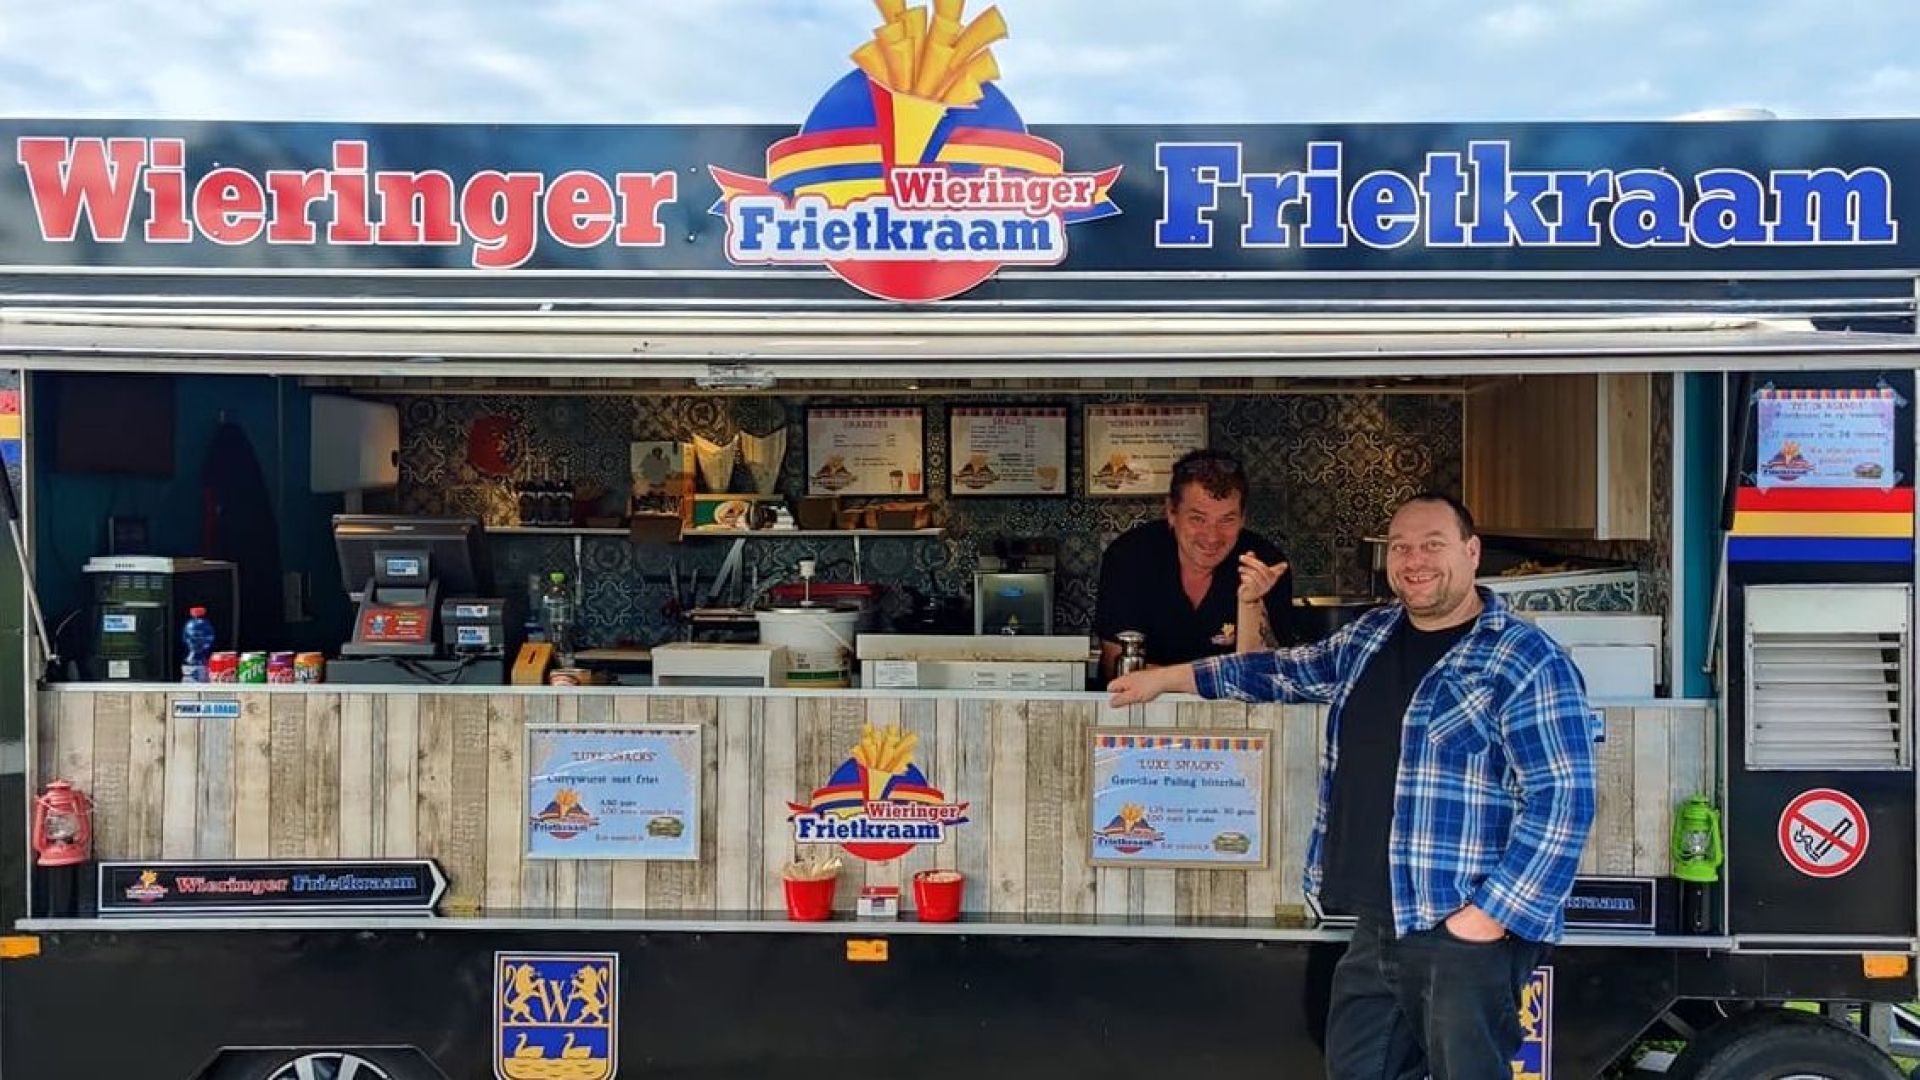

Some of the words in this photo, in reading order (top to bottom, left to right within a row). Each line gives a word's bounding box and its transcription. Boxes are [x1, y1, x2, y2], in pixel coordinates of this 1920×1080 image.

[17, 137, 677, 269] Wieringer
[894, 171, 1091, 208] Wieringer
[1155, 140, 1898, 248] Frietkraam
[739, 206, 1052, 251] Frietkraam
[799, 818, 940, 839] Frietkraam
[868, 802, 958, 820] Wieringer
[175, 876, 288, 895] Wieringer
[291, 874, 417, 892] Frietkraam
